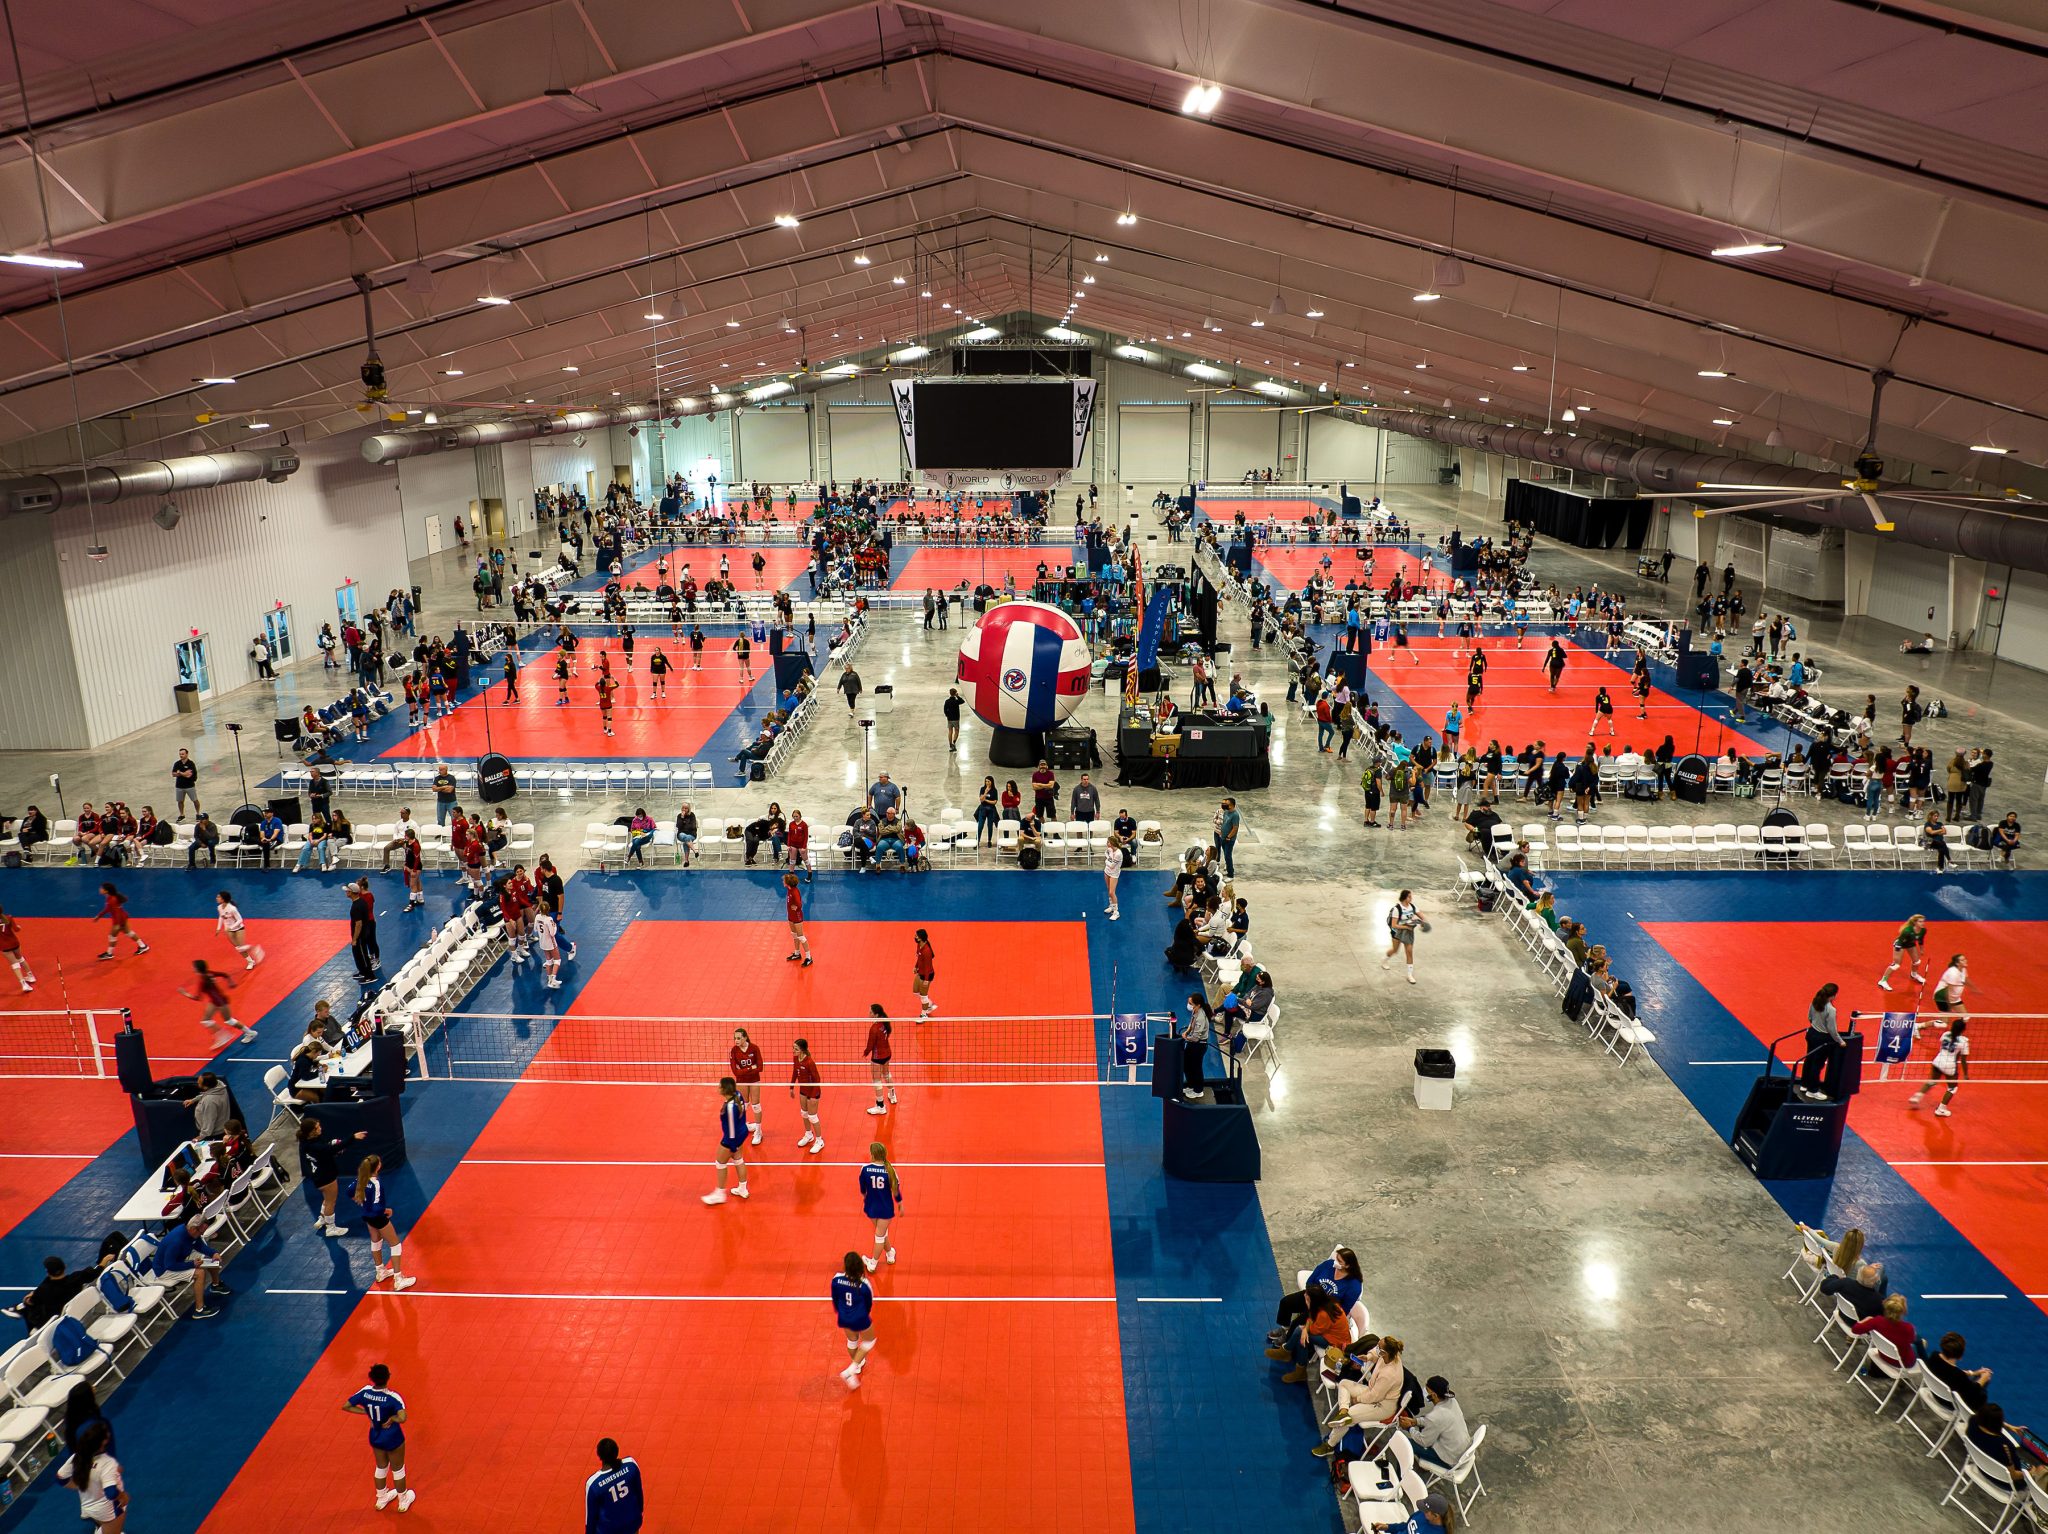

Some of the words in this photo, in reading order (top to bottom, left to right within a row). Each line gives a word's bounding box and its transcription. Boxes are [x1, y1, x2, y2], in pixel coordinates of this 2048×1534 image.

[1017, 474, 1047, 483] WORLD
[1379, 628, 1385, 637] 8
[1115, 1020, 1146, 1030] COURT
[1882, 1019, 1914, 1029] COURT
[1125, 1036, 1137, 1053] 5
[1887, 1034, 1901, 1053] 4
[870, 1175, 885, 1189] 16
[845, 1292, 853, 1307] 9
[367, 1403, 381, 1422] 11
[598, 1466, 629, 1488] GAINESVILLE
[608, 1479, 629, 1503] 15
